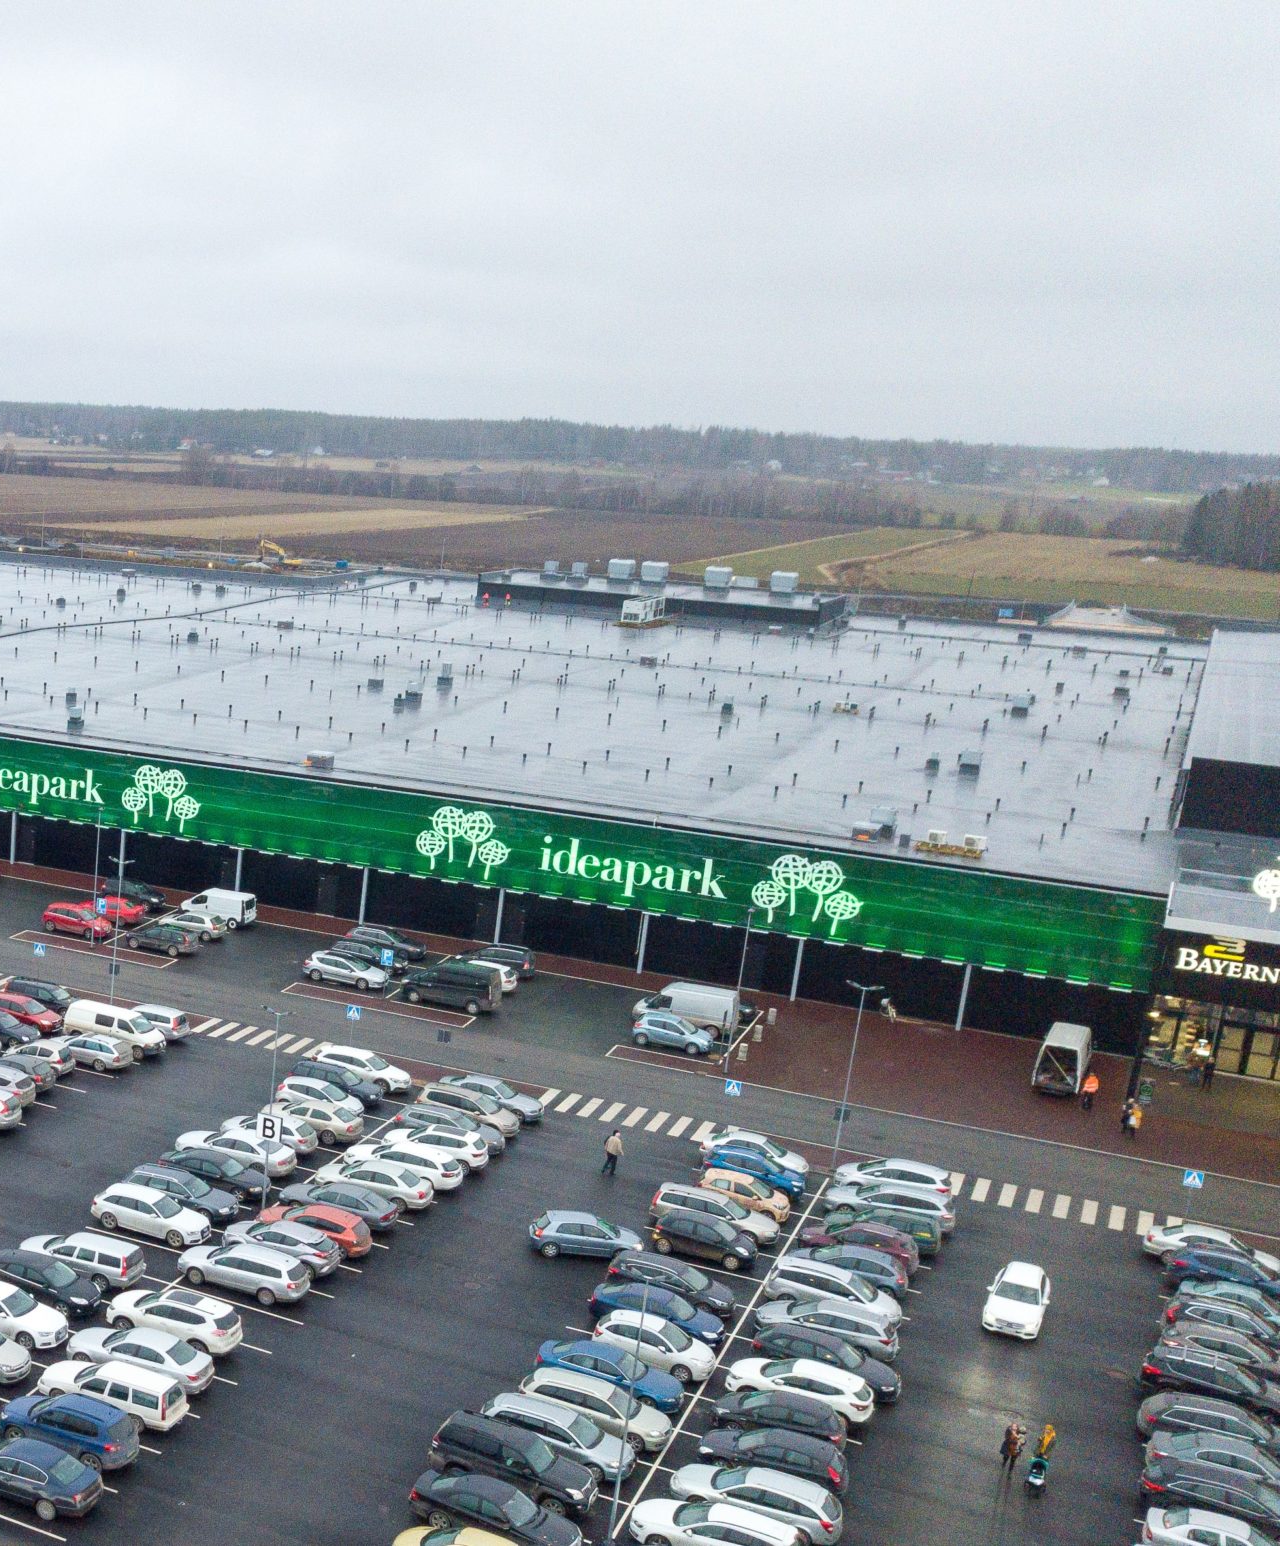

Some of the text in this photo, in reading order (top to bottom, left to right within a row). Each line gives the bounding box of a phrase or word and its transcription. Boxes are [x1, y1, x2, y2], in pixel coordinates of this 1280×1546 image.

[538, 835, 728, 900] ideapark
[1175, 947, 1280, 984] BAYERN
[262, 1117, 275, 1139] B
